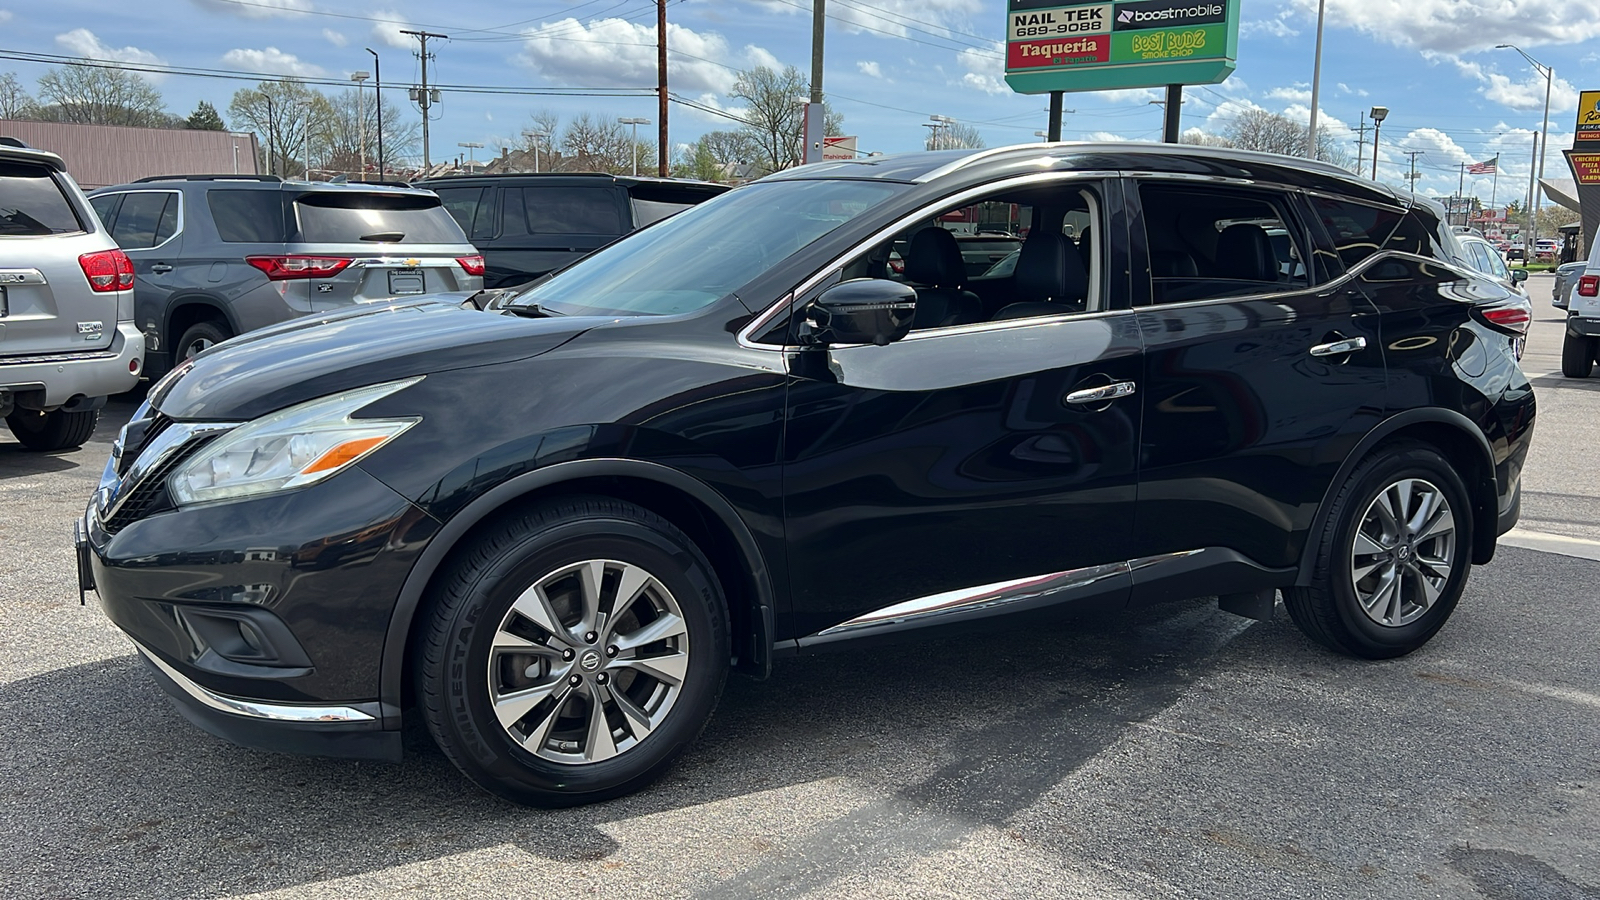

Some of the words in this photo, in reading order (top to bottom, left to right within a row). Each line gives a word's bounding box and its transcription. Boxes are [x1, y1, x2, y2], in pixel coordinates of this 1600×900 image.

[1015, 13, 1056, 27] NAIL
[1064, 8, 1103, 21] TEK
[1016, 21, 1101, 36] 689-9088
[1141, 50, 1169, 59] SMOKE
[1170, 48, 1193, 57] SHOP
[452, 603, 483, 743] MILESTAR
